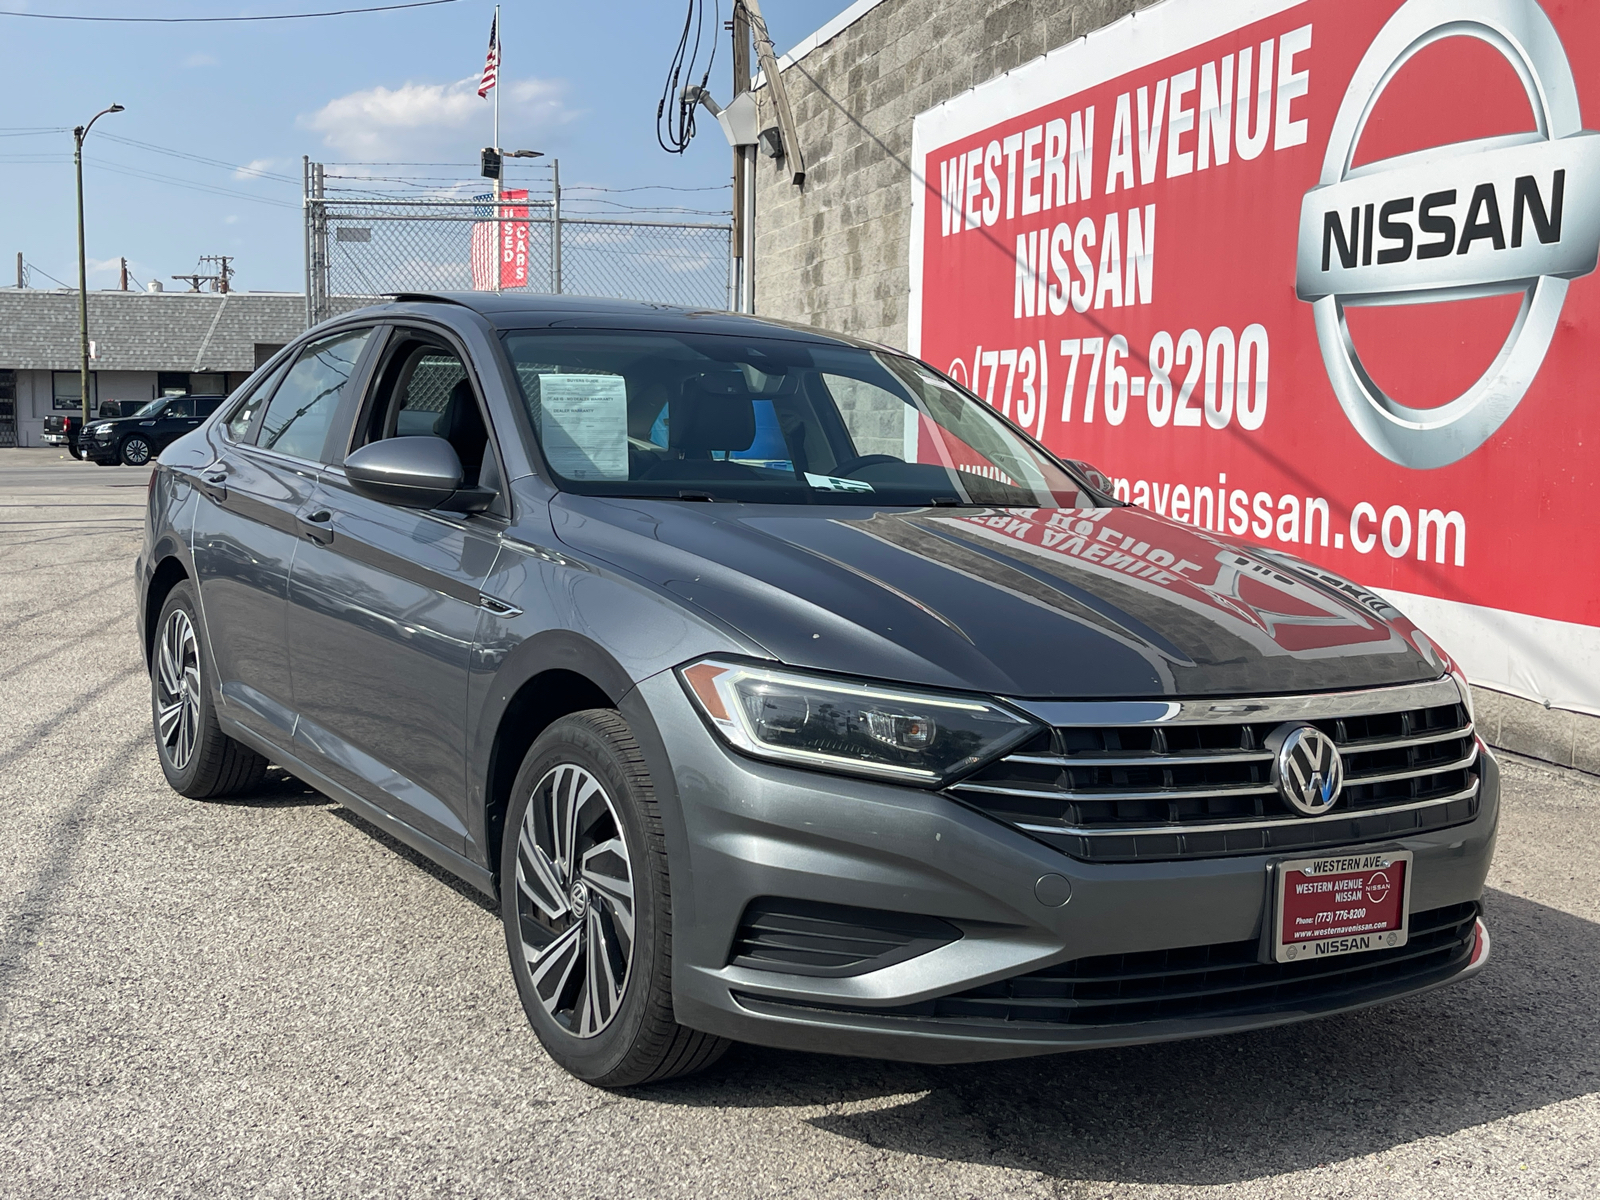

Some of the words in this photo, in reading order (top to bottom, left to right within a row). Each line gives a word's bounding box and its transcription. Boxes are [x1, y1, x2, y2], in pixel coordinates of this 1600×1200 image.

[940, 106, 1095, 237] WESTERN
[1106, 24, 1313, 193] AVENUE
[1321, 168, 1565, 271] NISSAN
[516, 226, 526, 279] CARS
[1013, 203, 1156, 319] NISSAN
[972, 337, 1048, 442] (773)
[1060, 323, 1270, 431] 776-8200
[1313, 859, 1361, 873] WESTERN
[1296, 881, 1333, 894] WESTERN
[1334, 878, 1363, 890] AVENUE
[1335, 890, 1362, 902] NISSAN
[1315, 911, 1333, 925] (773)
[1334, 908, 1366, 920] 776-8200
[1294, 921, 1387, 938] www.westernavenissan.com
[1315, 936, 1370, 955] NISSAN
